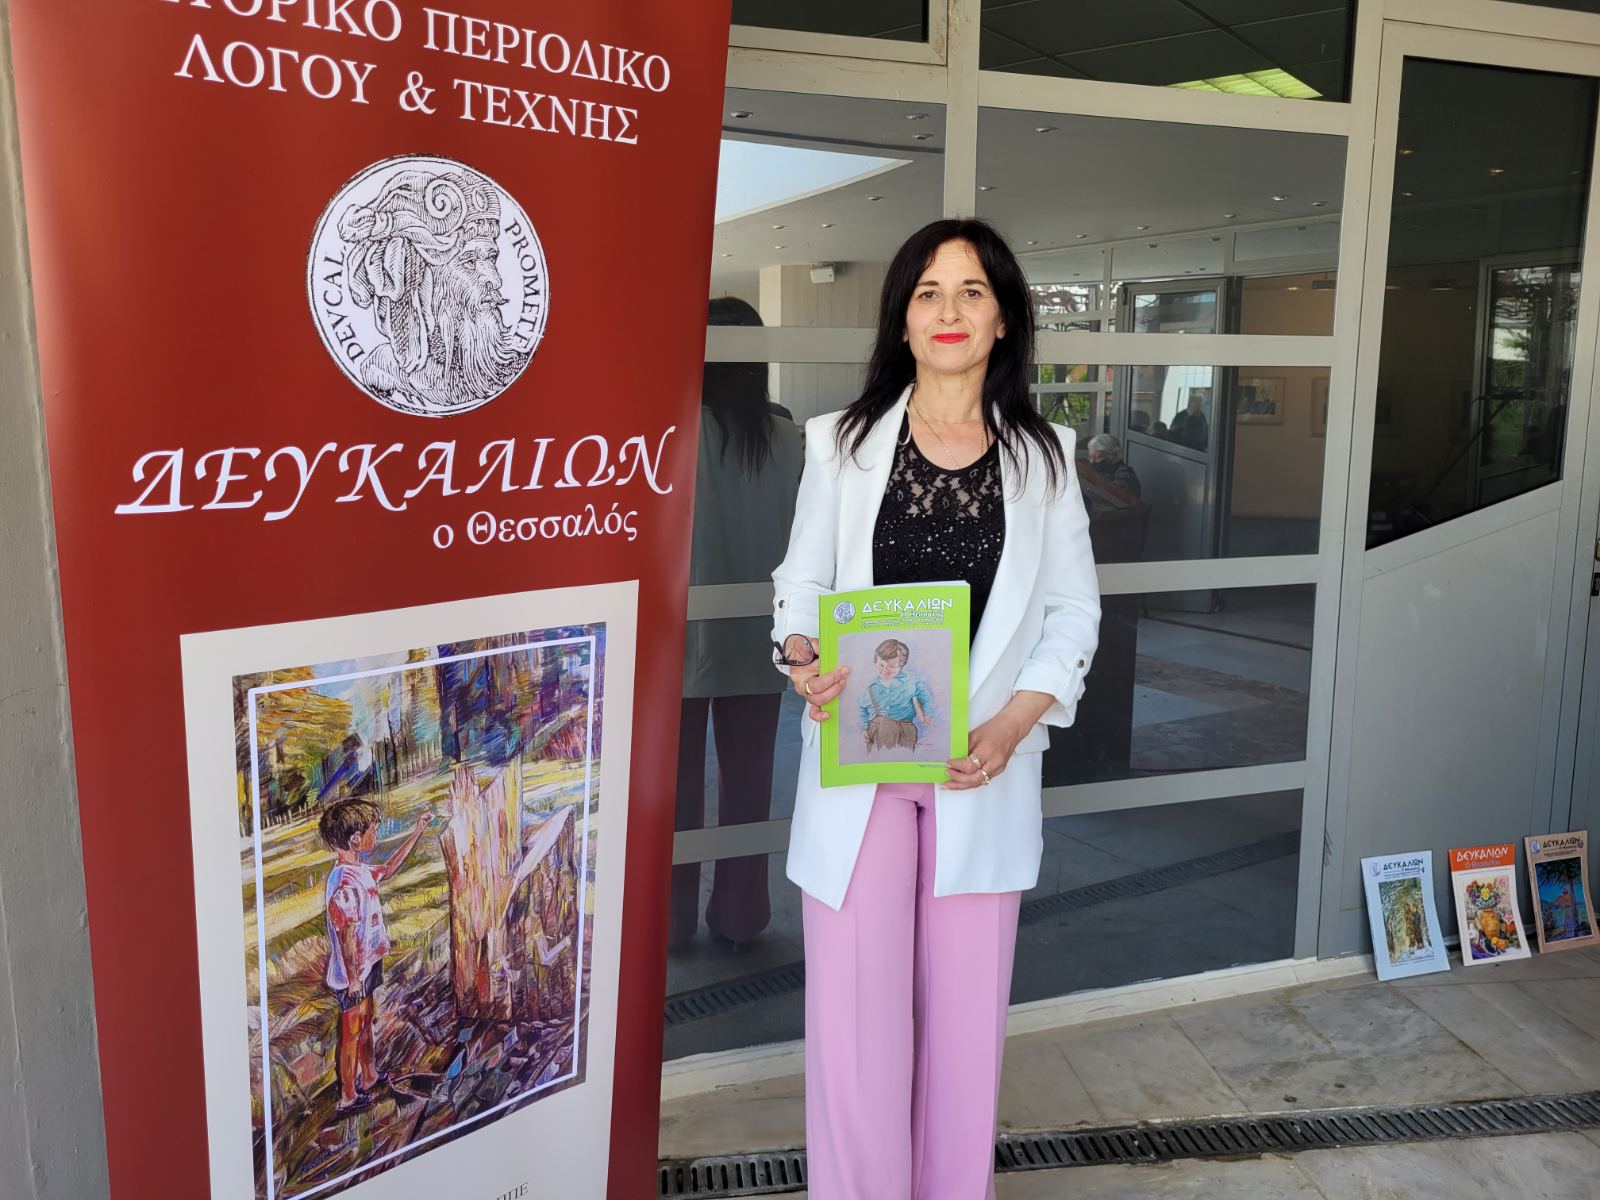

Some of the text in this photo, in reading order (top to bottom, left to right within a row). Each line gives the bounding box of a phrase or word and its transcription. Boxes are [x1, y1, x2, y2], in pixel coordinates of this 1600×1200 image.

[163, 0, 671, 93] ΡΙΚΟ ΠΕΡΙΟΔΙΚΟ
[174, 33, 638, 145] ΛΟΓΟΥ & ΤΕΧΝΗΣ
[113, 425, 676, 522] ΔΕΥΚΑΛΙΩΝ
[466, 503, 638, 546] Θεσσαλός
[861, 598, 953, 614] ΔΕΥΚΑΛΙΩΝ
